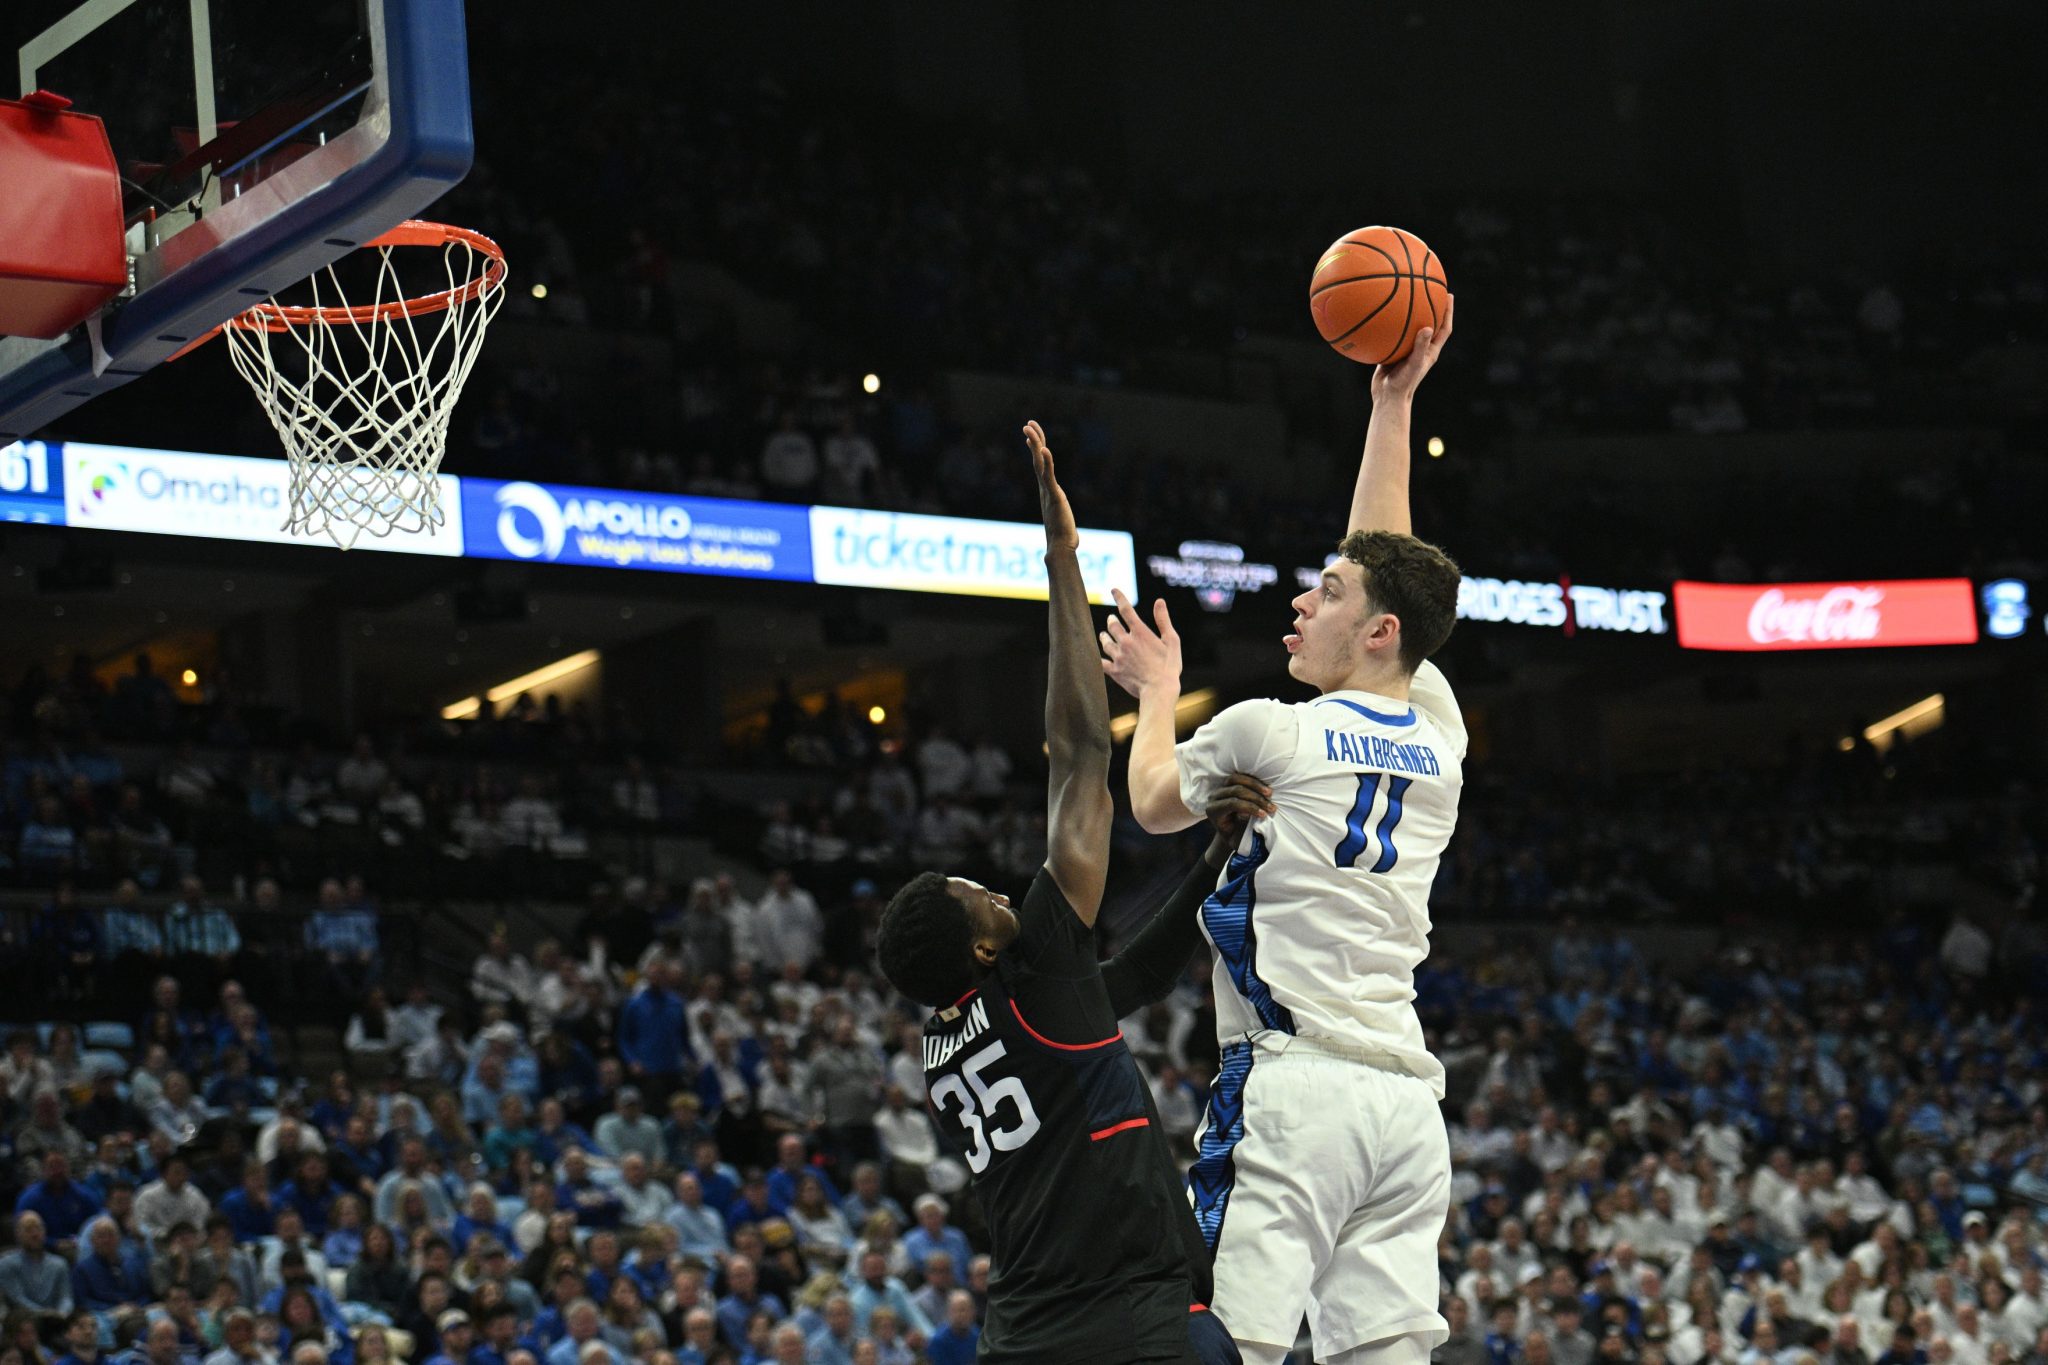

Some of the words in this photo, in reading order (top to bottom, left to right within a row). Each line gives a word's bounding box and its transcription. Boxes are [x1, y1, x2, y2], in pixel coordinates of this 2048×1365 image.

[135, 465, 281, 509] Omaha
[563, 498, 692, 540] APOLLO
[833, 511, 1113, 585] ticketmaser
[1456, 575, 1567, 627] RIDGES
[1568, 585, 1667, 635] TRUST
[1334, 772, 1413, 873] 11
[930, 1039, 1041, 1174] 35
